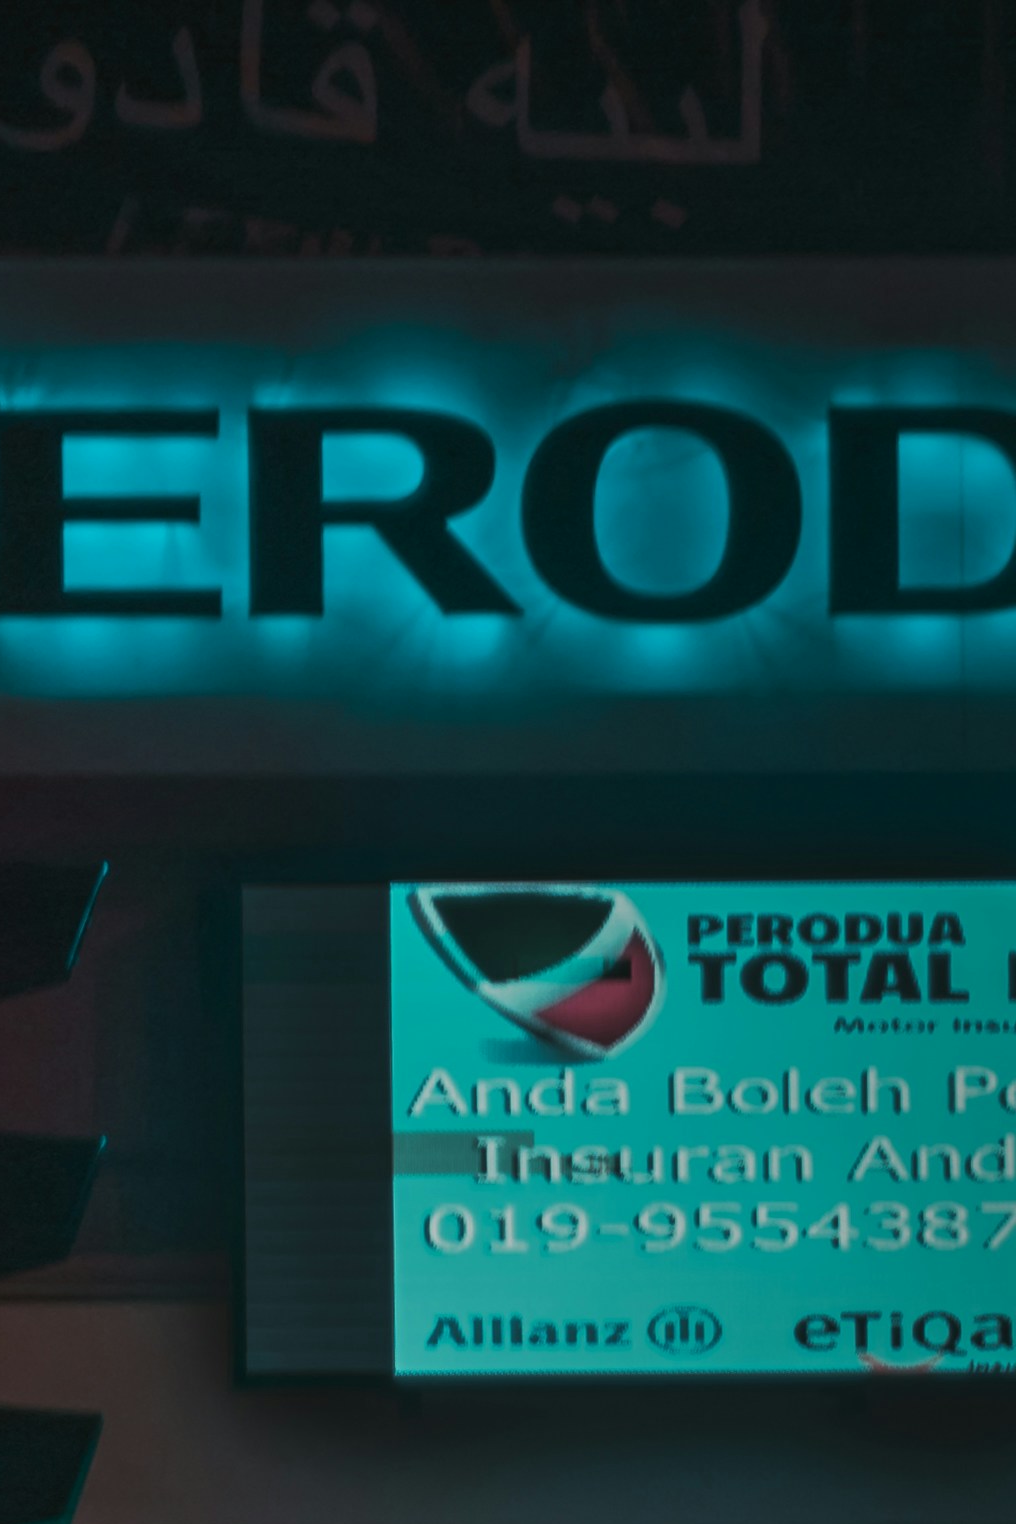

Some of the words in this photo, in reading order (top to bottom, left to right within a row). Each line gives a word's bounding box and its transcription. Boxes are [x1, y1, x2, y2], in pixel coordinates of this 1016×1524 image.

[687, 911, 967, 949] PERODUA
[687, 951, 971, 1006] TOTAL
[834, 1015, 938, 1035] Motor
[407, 1067, 631, 1118] Anda
[668, 1065, 911, 1117] Boleh
[474, 1134, 814, 1185] Insuran
[847, 1133, 1016, 1184] And
[424, 1202, 1016, 1254] 019-9554387
[426, 1314, 632, 1348] Allianz
